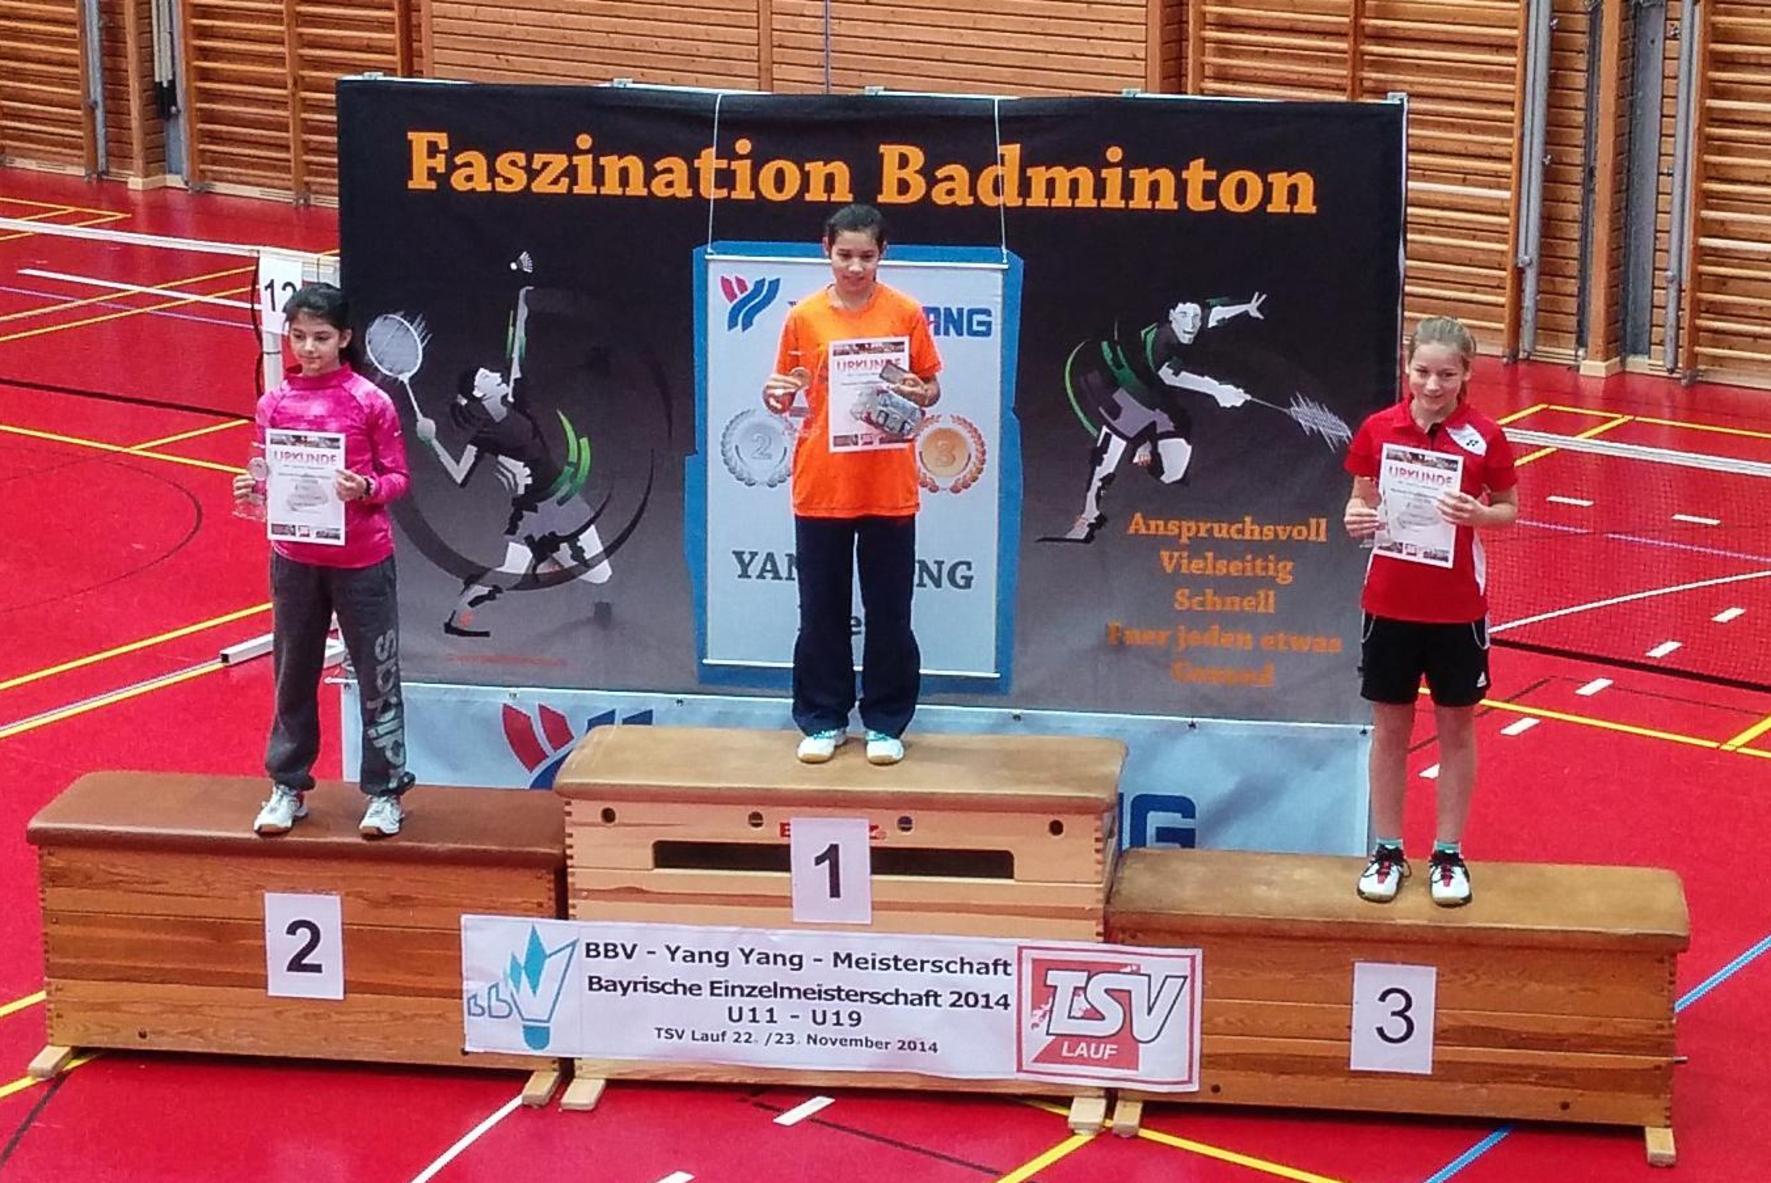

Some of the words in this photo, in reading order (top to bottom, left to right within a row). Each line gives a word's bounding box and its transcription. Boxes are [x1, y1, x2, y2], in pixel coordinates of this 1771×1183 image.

[407, 131, 853, 202] Faszination
[877, 143, 1317, 214] Badminton
[922, 306, 993, 338] ANG
[274, 450, 337, 466] URKUNDE
[1388, 465, 1453, 487] URKUNDE
[1127, 512, 1328, 544] Anspruchsvoll
[1159, 550, 1295, 585] Vielseitig
[1174, 588, 1276, 614] Schnell
[1176, 624, 1253, 653] jeden
[1260, 632, 1343, 654] etwas
[814, 843, 841, 899] 1
[285, 919, 323, 974] 2
[585, 942, 638, 960] BBV
[665, 944, 729, 968] Yang
[738, 947, 804, 971] Yang
[832, 951, 1013, 977] Meisterschaft
[587, 975, 702, 997] Bayrische
[709, 980, 943, 1008] Einzelmeisterschaft
[949, 992, 1011, 1011] 2014
[1045, 967, 1189, 1044] TSV
[727, 1006, 779, 1024] U11
[811, 1009, 863, 1027] U19
[1375, 987, 1415, 1044] 3
[654, 1027, 686, 1041] TSV
[691, 1030, 728, 1043] Lauf
[806, 1034, 892, 1050] November
[897, 1040, 939, 1054] 2014
[1061, 1040, 1119, 1060] LAUF
